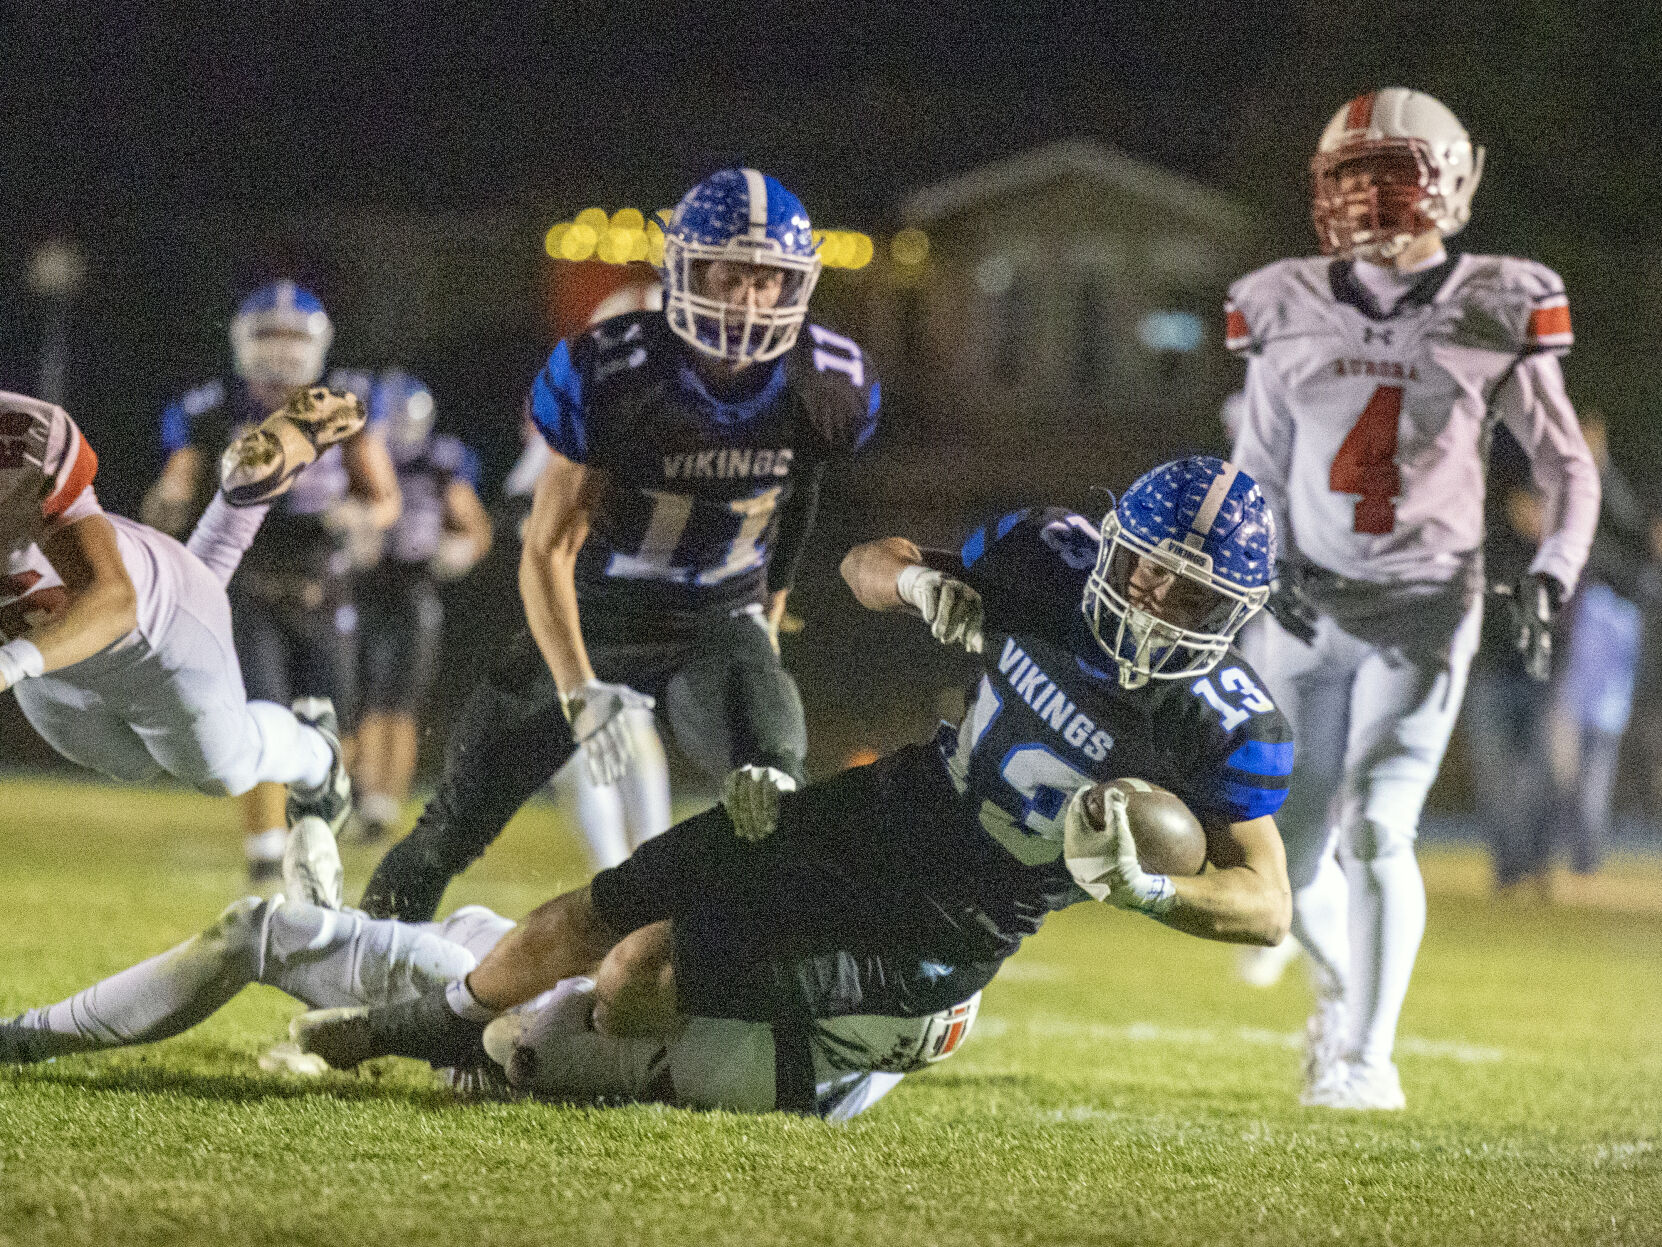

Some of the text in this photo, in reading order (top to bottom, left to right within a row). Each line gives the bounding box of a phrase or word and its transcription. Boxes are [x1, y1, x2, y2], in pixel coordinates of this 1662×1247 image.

[809, 324, 864, 387] 11
[1329, 385, 1405, 535] 4
[606, 486, 783, 586] 11
[998, 636, 1115, 762] VIKINGS
[1189, 665, 1276, 733] 13
